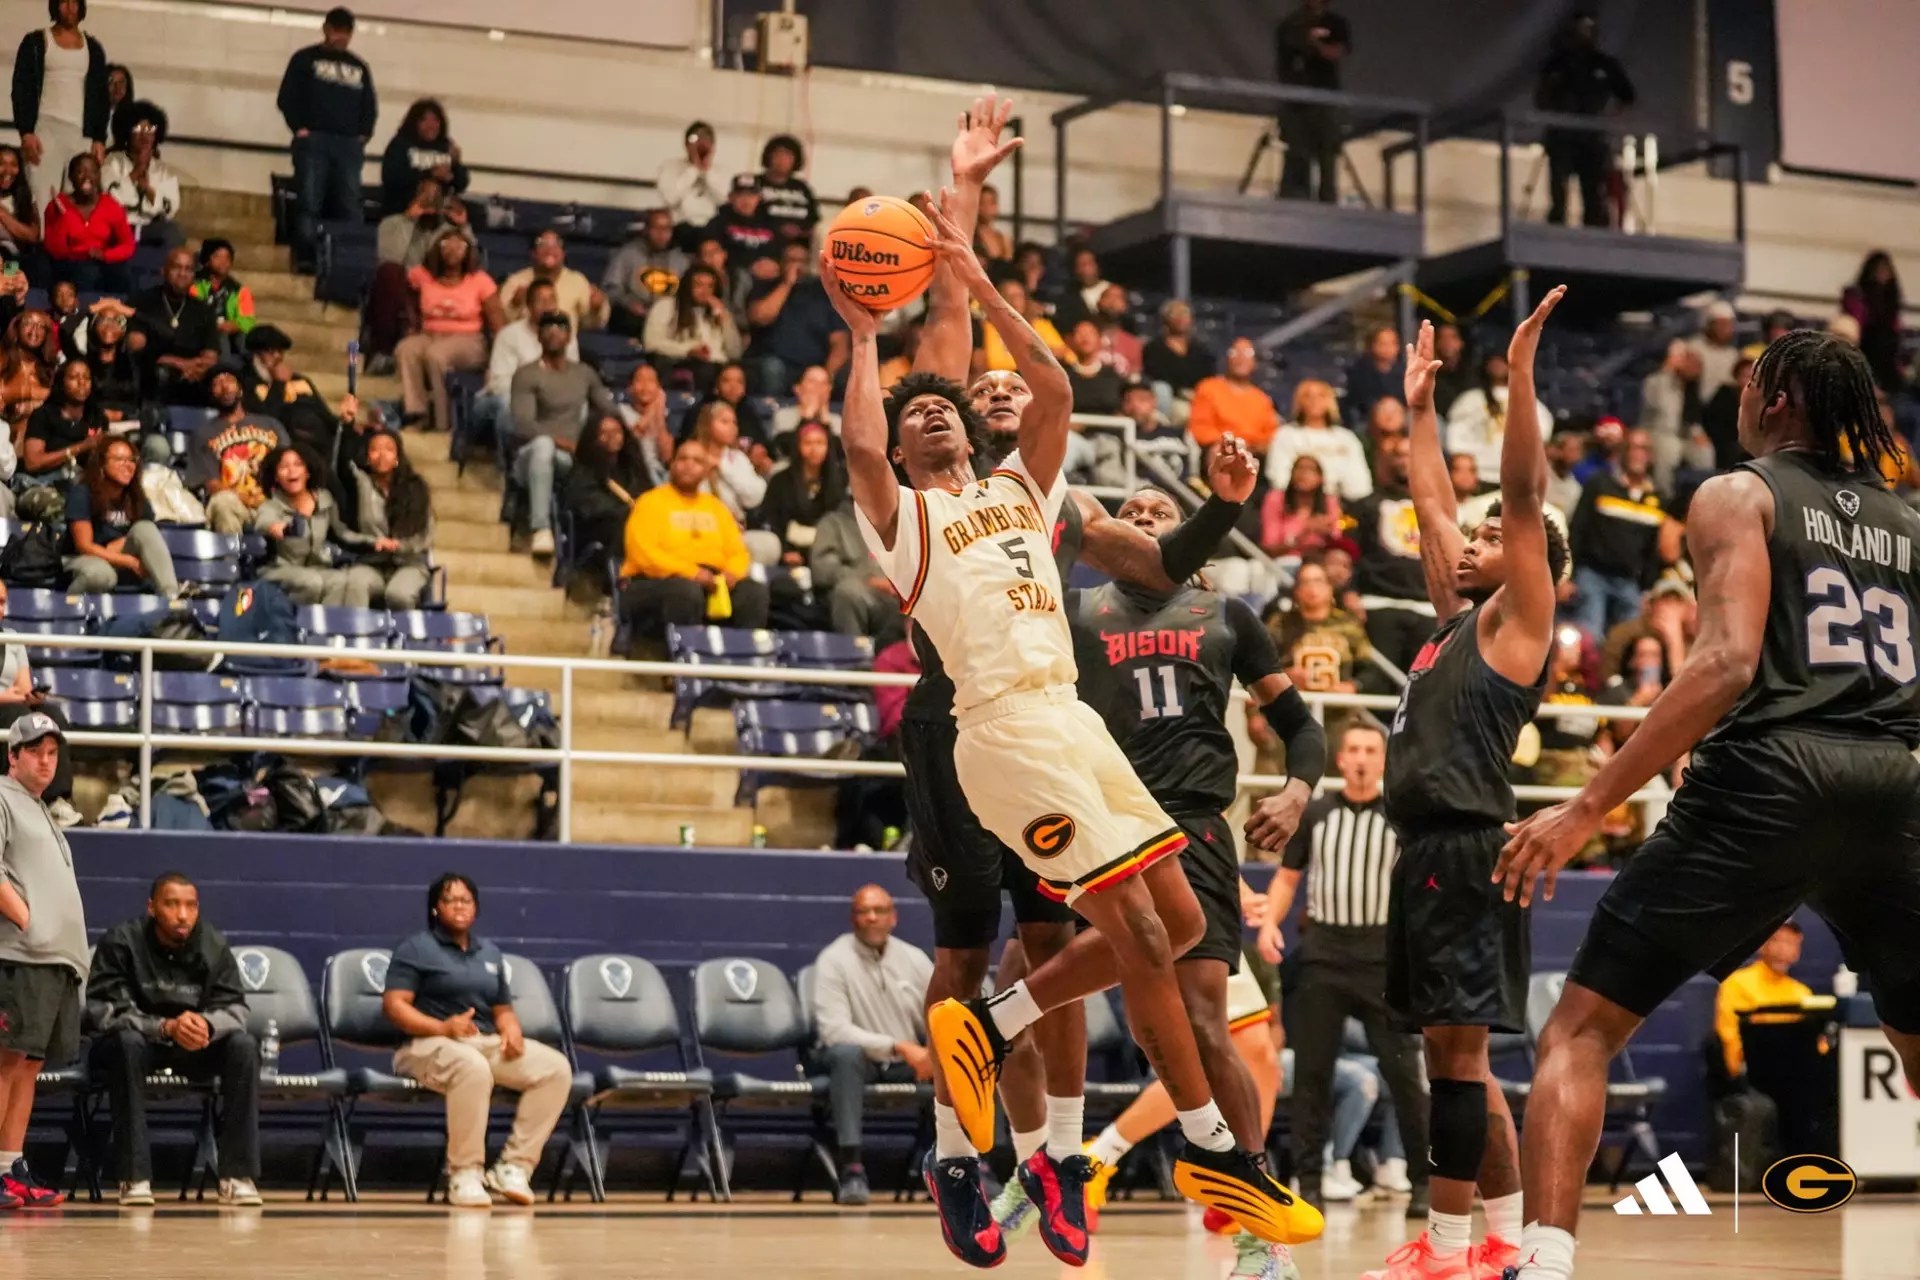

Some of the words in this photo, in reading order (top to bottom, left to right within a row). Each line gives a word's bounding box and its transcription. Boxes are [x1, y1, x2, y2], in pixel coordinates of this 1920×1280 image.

[1728, 61, 1754, 105] 5
[832, 240, 899, 266] Wilson
[840, 279, 889, 297] NCAA
[998, 536, 1034, 579] 5
[1803, 506, 1891, 566] HOLLAND
[1896, 534, 1911, 574] III
[1100, 625, 1205, 667] BISON
[1806, 566, 1917, 684] 23
[1133, 665, 1183, 720] 11
[1863, 1047, 1914, 1101] R
